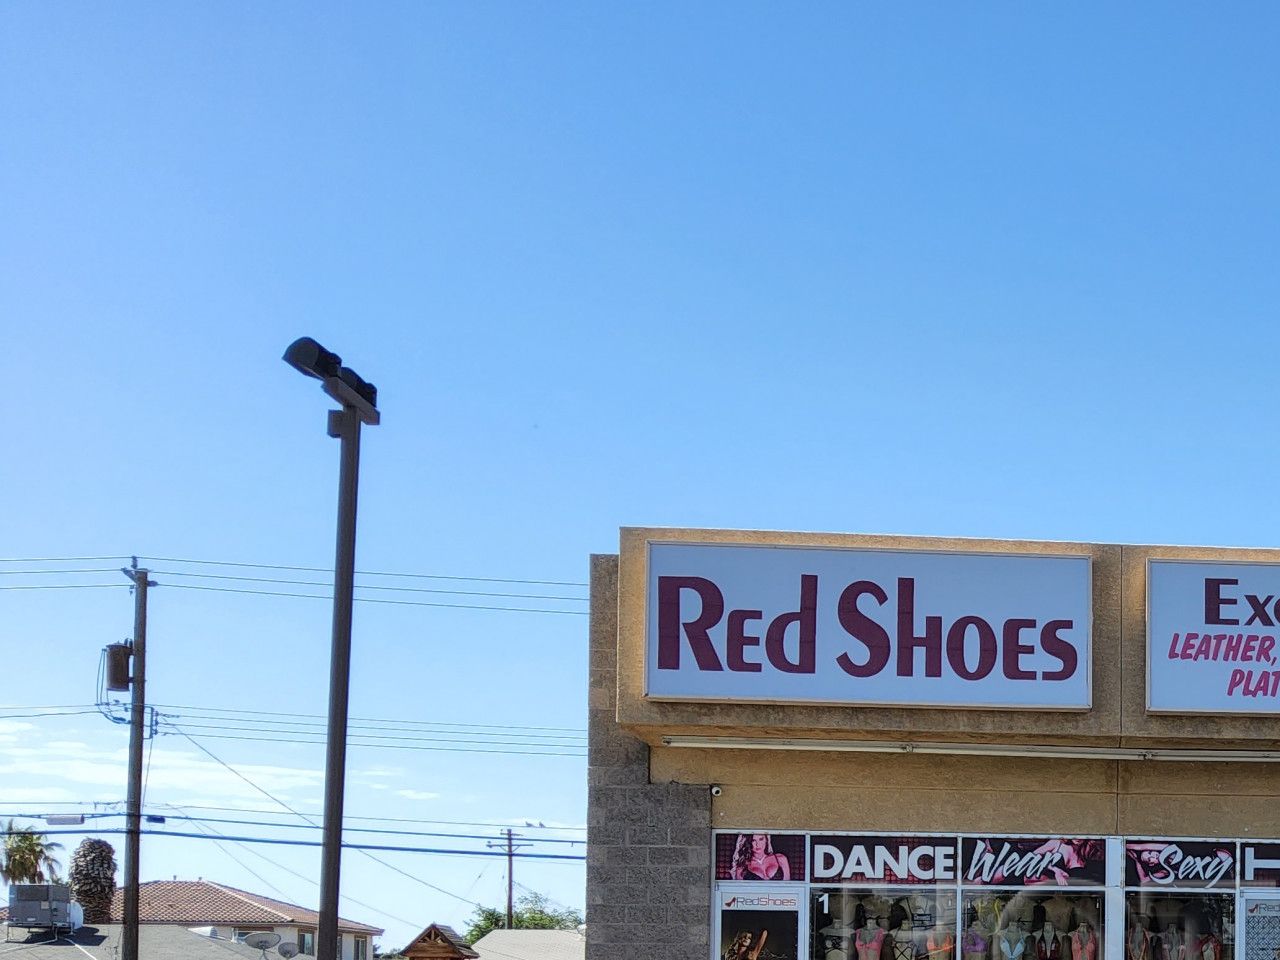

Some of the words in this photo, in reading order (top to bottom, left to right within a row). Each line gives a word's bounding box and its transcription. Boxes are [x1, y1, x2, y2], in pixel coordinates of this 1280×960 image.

[657, 574, 818, 673] Red
[1168, 633, 1277, 663] LEATHER,
[814, 845, 955, 879] DANCE
[967, 840, 1064, 883] Wear
[1153, 845, 1234, 889] Sexy
[818, 893, 829, 914] 1
